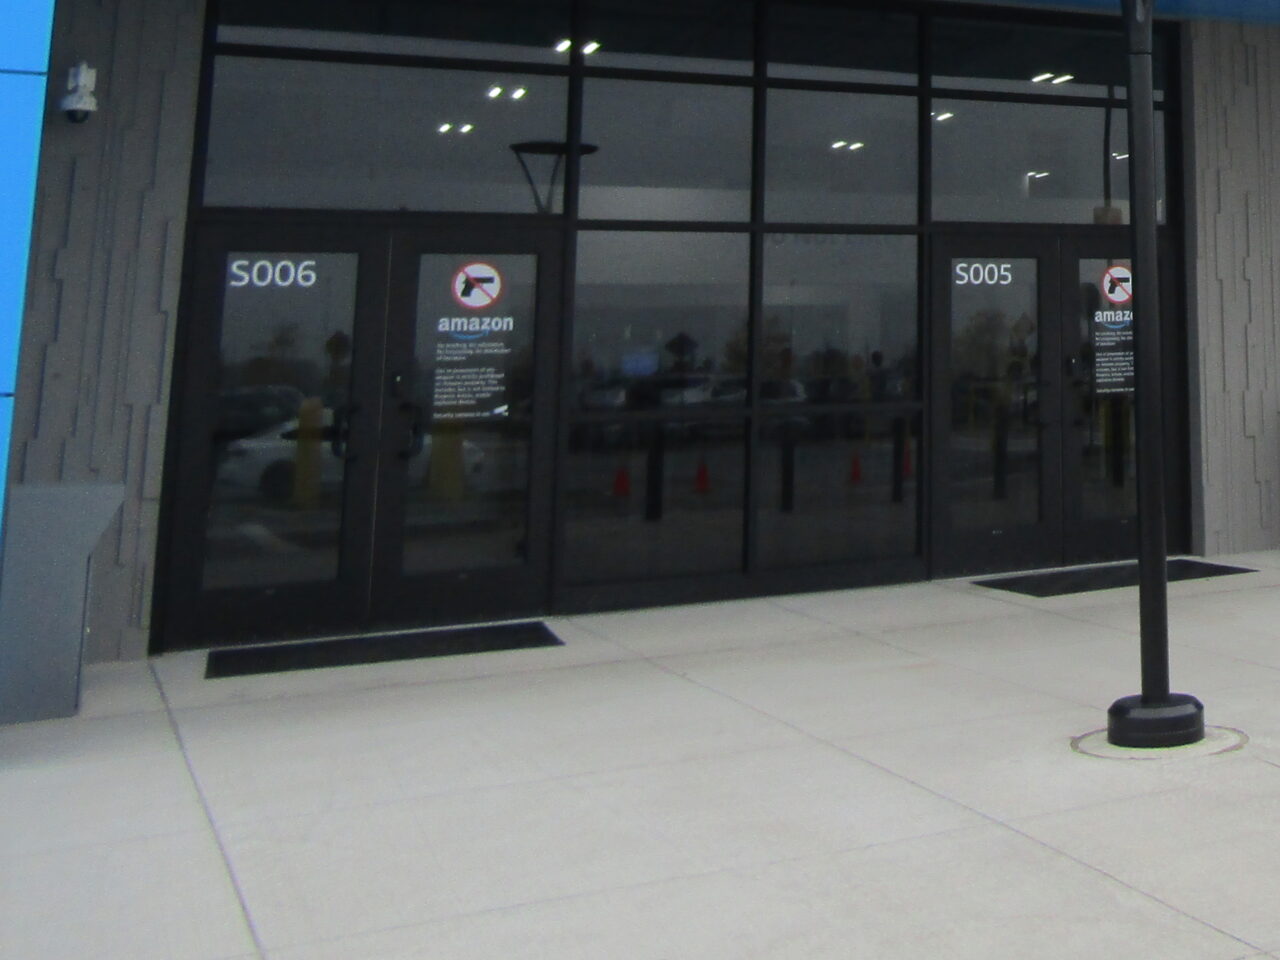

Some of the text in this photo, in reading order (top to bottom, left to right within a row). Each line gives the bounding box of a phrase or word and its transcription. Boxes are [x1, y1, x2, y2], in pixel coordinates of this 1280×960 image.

[229, 260, 317, 287] S006
[955, 263, 1012, 285] S005
[437, 315, 514, 332] amazon
[1094, 310, 1133, 322] amaz
